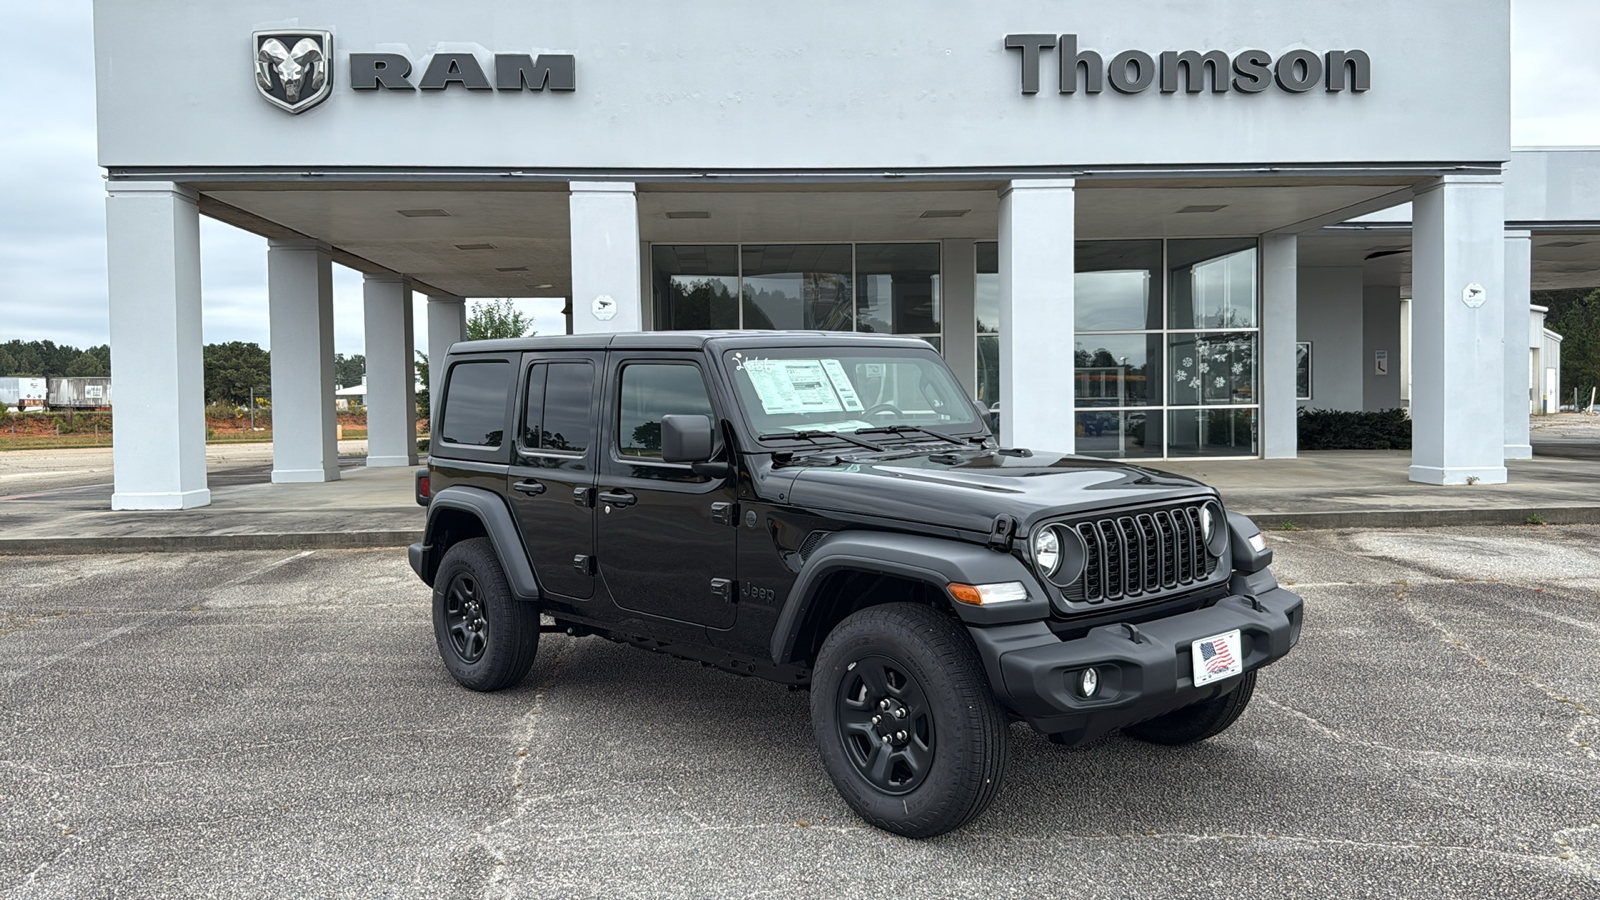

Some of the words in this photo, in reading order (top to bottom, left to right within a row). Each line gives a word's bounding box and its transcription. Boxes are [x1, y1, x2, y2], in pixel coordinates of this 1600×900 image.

[349, 52, 576, 91] RAM
[1004, 33, 1371, 95] Thomson
[741, 581, 775, 604] Jeep
